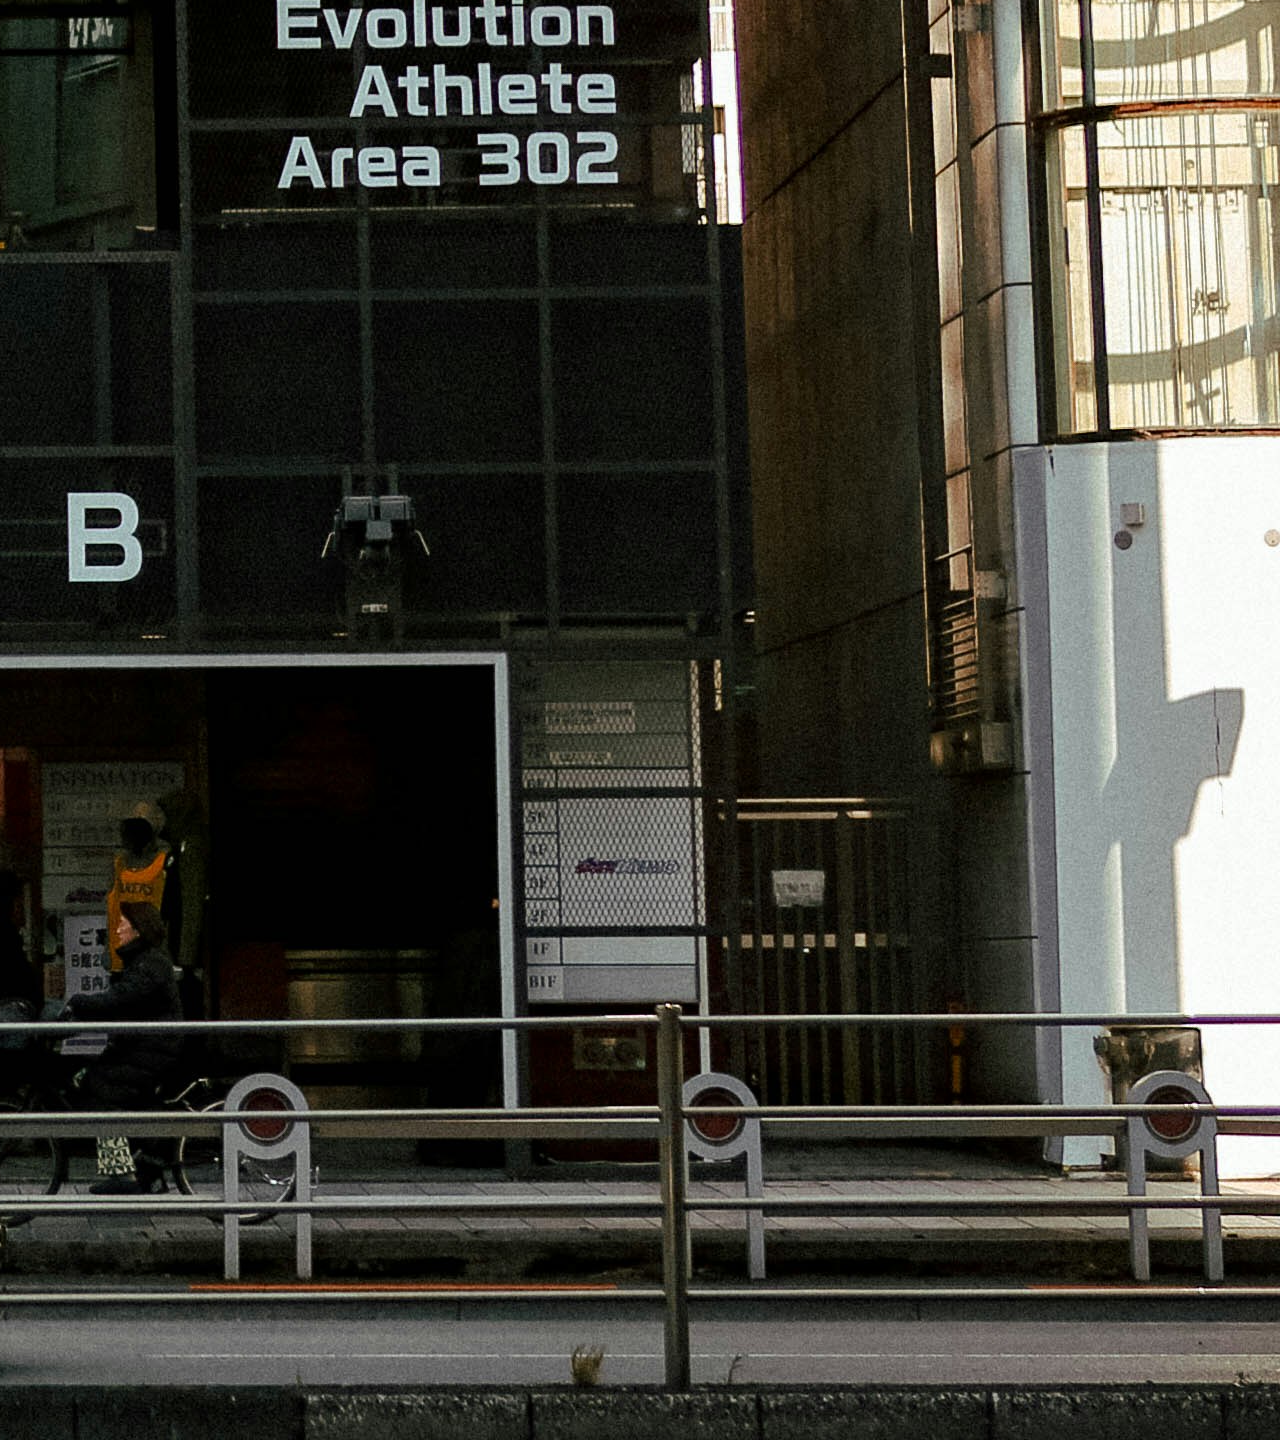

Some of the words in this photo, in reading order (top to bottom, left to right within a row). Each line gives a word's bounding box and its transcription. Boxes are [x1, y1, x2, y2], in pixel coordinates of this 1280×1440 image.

[349, 62, 617, 118] Athlete
[277, 136, 441, 189] Area
[477, 131, 619, 186] 302
[66, 492, 143, 582] B
[528, 975, 556, 989] B1F
